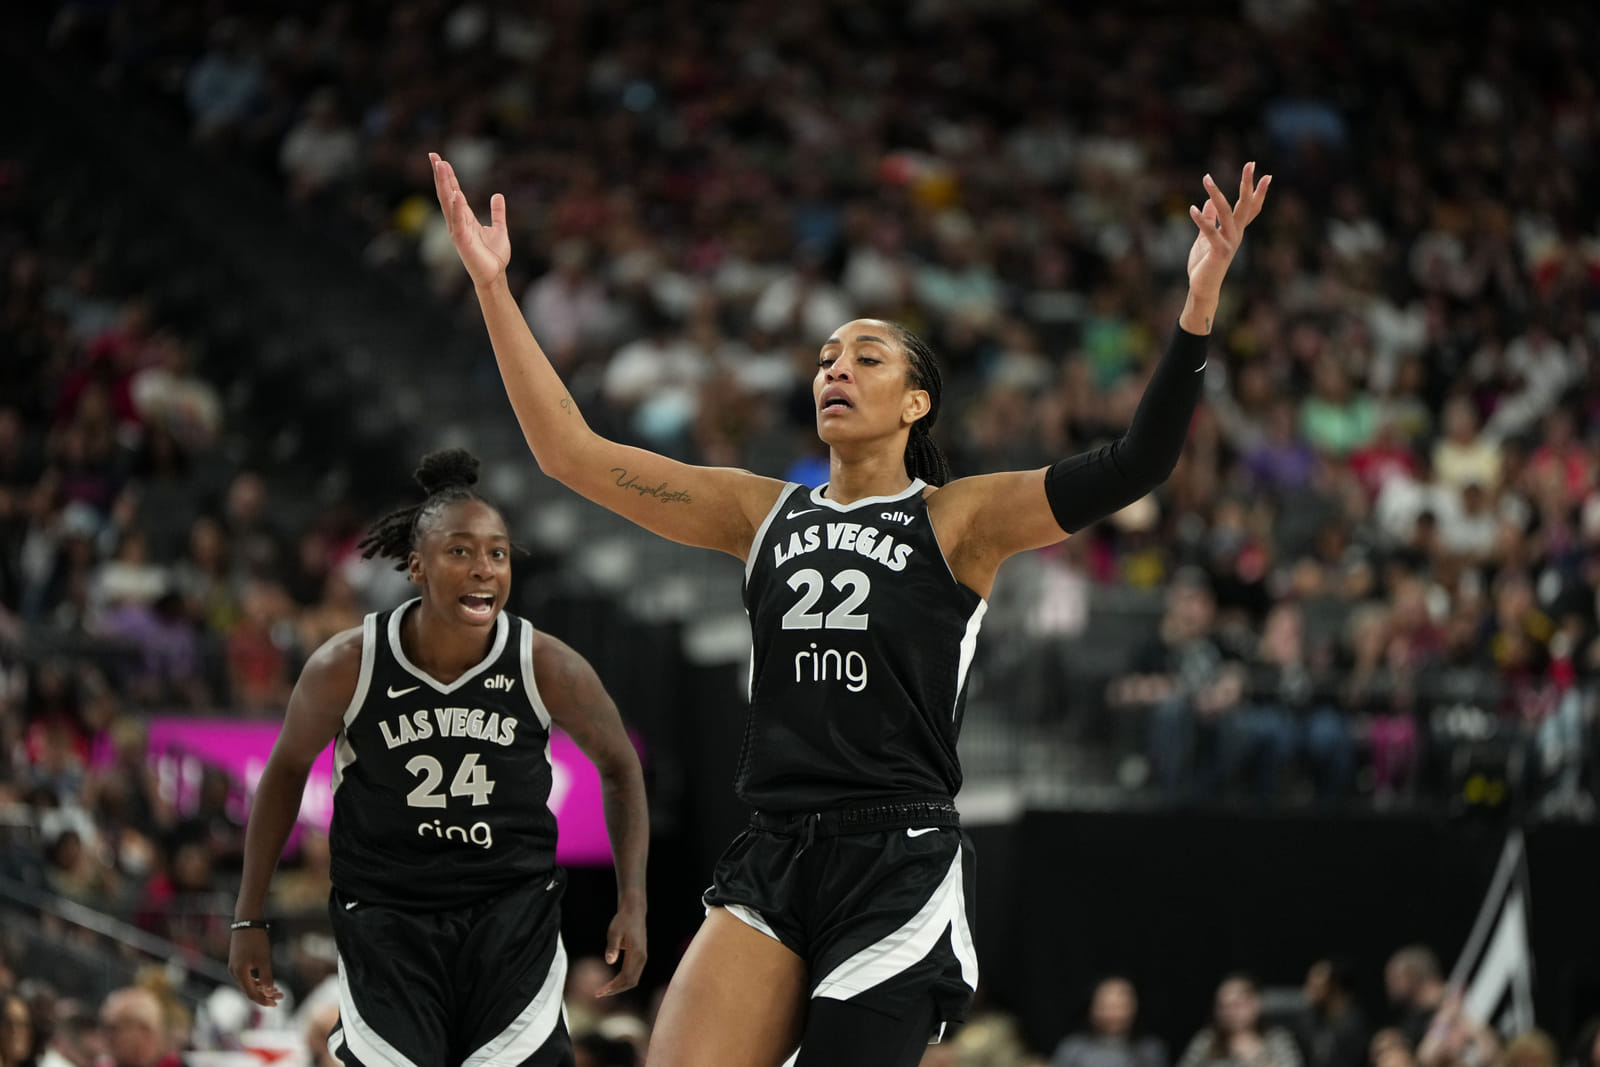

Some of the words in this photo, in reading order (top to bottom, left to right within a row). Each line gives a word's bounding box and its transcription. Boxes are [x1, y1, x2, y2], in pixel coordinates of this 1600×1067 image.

[880, 511, 916, 526] ally
[774, 525, 821, 568] LAS
[826, 522, 914, 572] VEGAS
[781, 568, 871, 631] 22
[484, 674, 515, 692] ally
[795, 642, 868, 692] ring
[378, 710, 433, 750] LAS
[434, 707, 518, 746] VEGAS
[404, 753, 496, 809] 24
[417, 819, 493, 849] ring
